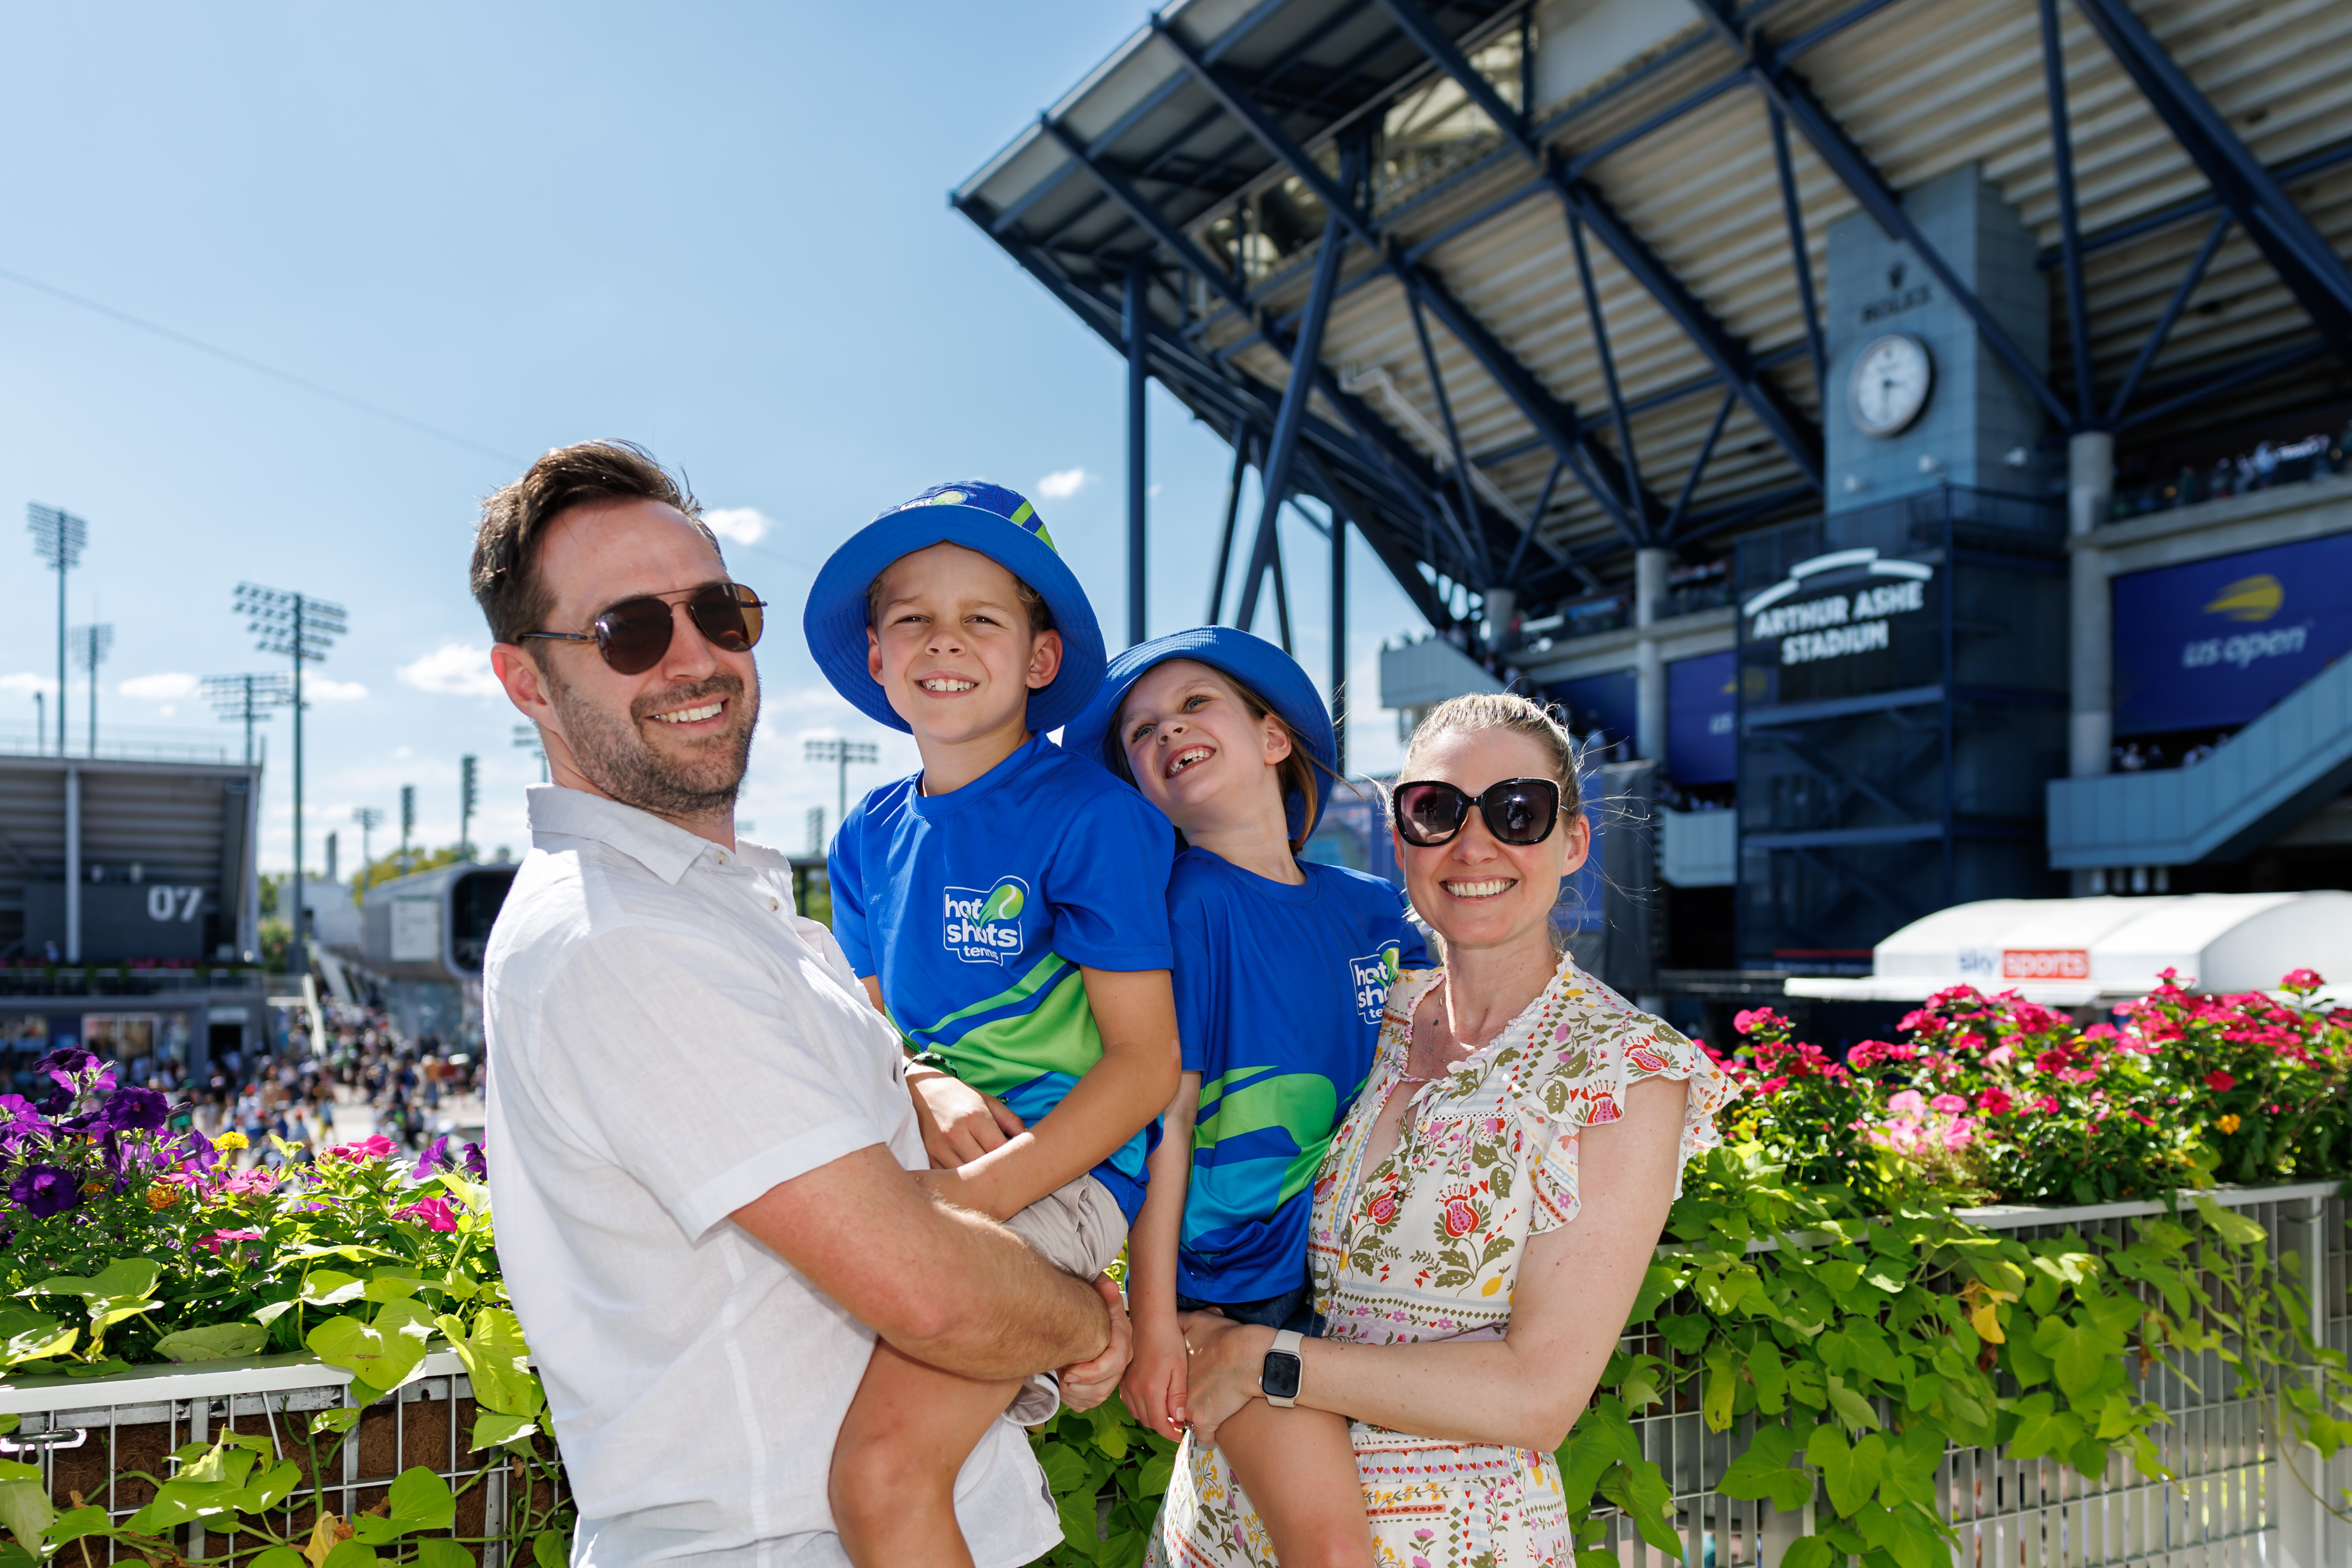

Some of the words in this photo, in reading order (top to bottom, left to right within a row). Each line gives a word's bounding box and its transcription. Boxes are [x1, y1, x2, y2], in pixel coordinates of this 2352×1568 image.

[1752, 595, 1849, 639] ARTHUR
[1852, 580, 1924, 621] ASHE
[1781, 619, 1889, 665] STADIUM
[2182, 638, 2221, 669] us
[2222, 625, 2308, 669] open
[148, 885, 203, 922] 07
[945, 893, 983, 920] hot
[946, 918, 1018, 947] shots
[963, 945, 999, 961] tenns
[2004, 951, 2088, 978] sports
[1354, 961, 1388, 986] hot
[1358, 981, 1394, 1008] sho
